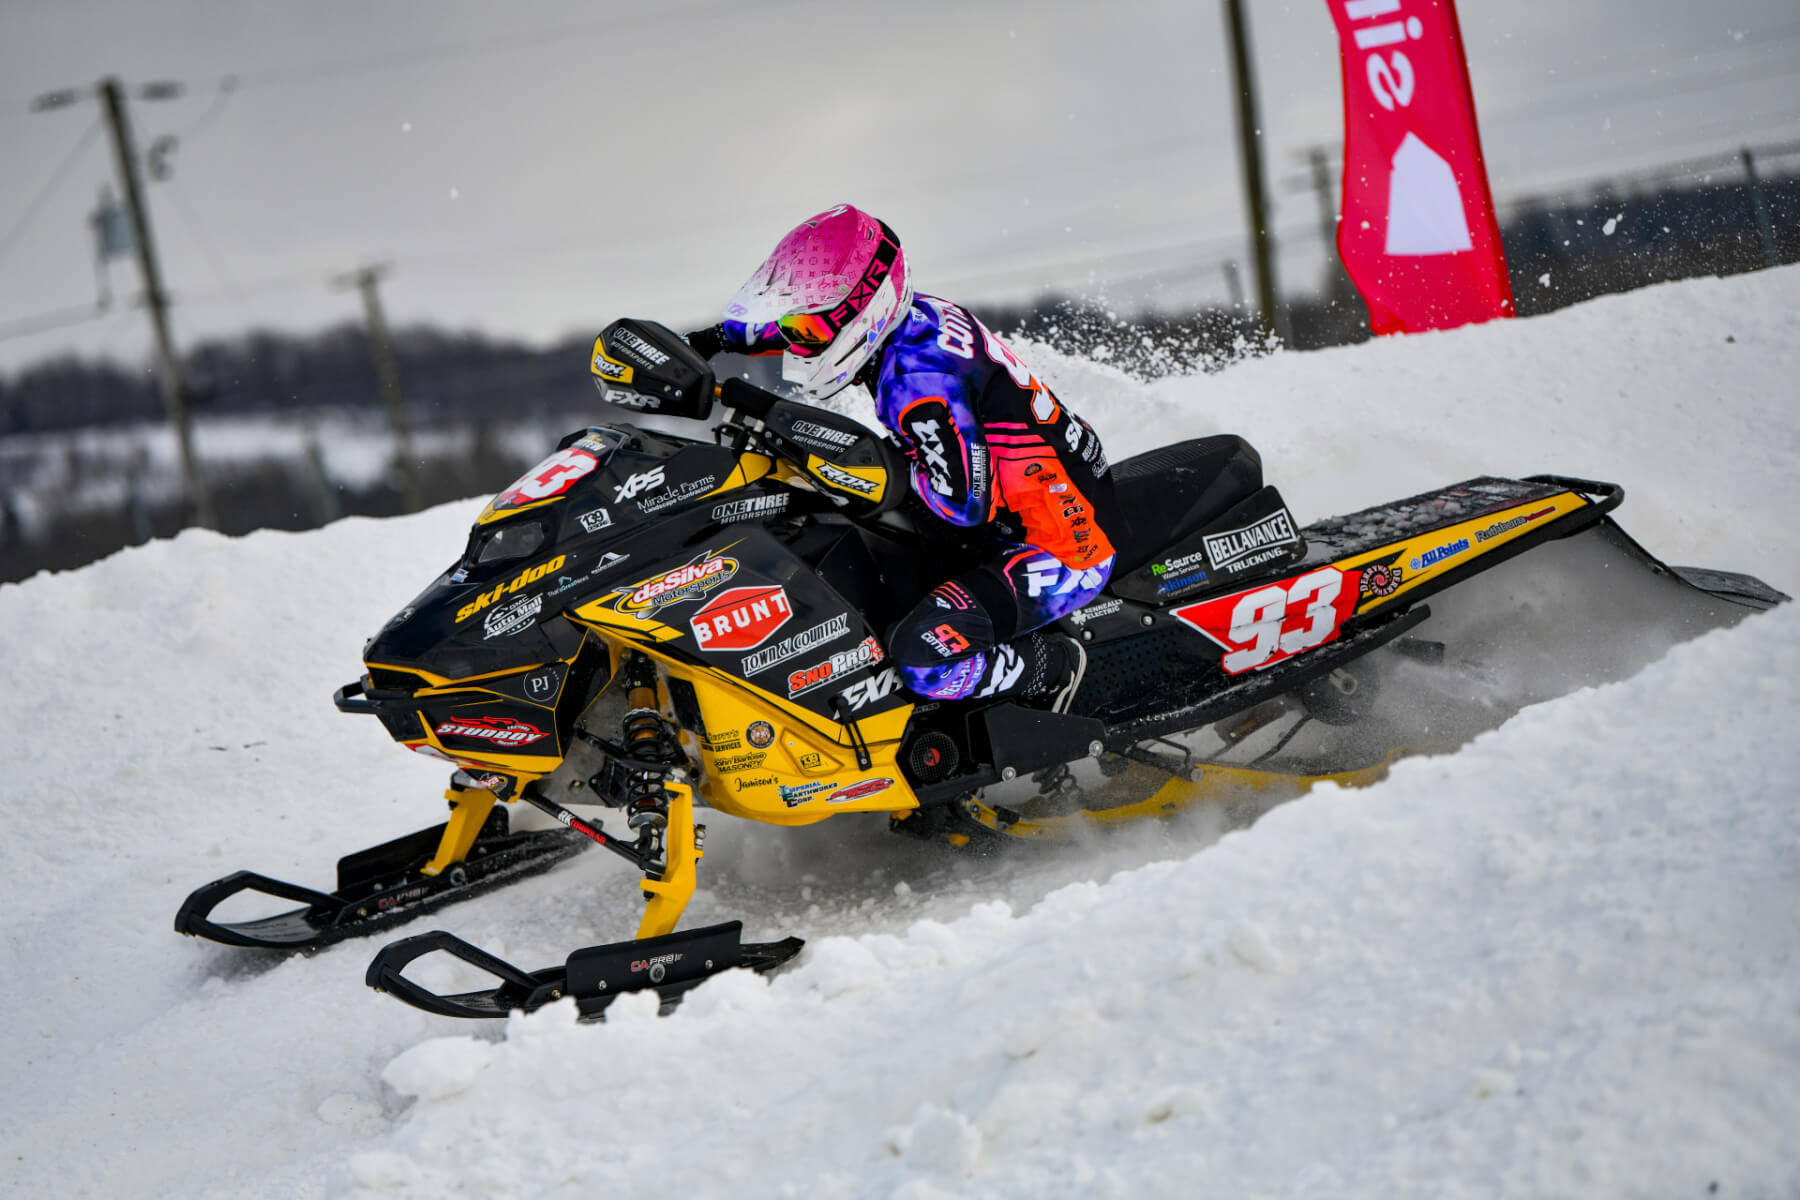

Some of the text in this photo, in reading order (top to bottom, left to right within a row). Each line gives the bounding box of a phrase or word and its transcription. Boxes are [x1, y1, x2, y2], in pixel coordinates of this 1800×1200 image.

[828, 258, 889, 329] FXR
[610, 341, 655, 370] MOTORSPORTS
[613, 327, 671, 366] ONETHREE
[594, 354, 626, 377] ROX
[605, 389, 661, 409] FXR
[792, 419, 859, 446] ONETHREE
[792, 434, 846, 453] MOTORSPORTS
[612, 465, 665, 504] XPS
[816, 462, 880, 493] ROX
[637, 474, 716, 511] Miracle Farms
[644, 483, 714, 514] Landscape Contractors
[711, 492, 791, 521] ONETHREE
[581, 510, 604, 527] 139
[720, 506, 786, 525] MOTORSPORTS
[1208, 514, 1292, 564] BELLAVANCE
[1421, 537, 1471, 569] All Points
[1152, 552, 1202, 576] ReSource
[1179, 563, 1201, 577] Services
[1225, 546, 1284, 574] TRUCKING
[454, 554, 567, 624] ski-doo
[632, 557, 725, 605] daSilva
[651, 567, 731, 608] Motorsports
[1158, 570, 1208, 595] Atkinson
[485, 614, 515, 637] Auto
[516, 596, 543, 617] Mall
[692, 591, 788, 643] BRUNT
[1086, 604, 1122, 620] ELECTRIC
[1222, 565, 1344, 675] 93
[742, 645, 777, 674] TOWN
[778, 637, 792, 656] &
[793, 612, 849, 651] COUNTRY
[919, 631, 954, 659] COTTEN
[933, 622, 972, 655] 93
[531, 676, 551, 693] PJ
[436, 723, 545, 743] STUDBOY
[782, 782, 838, 802] EARTHWORKS
